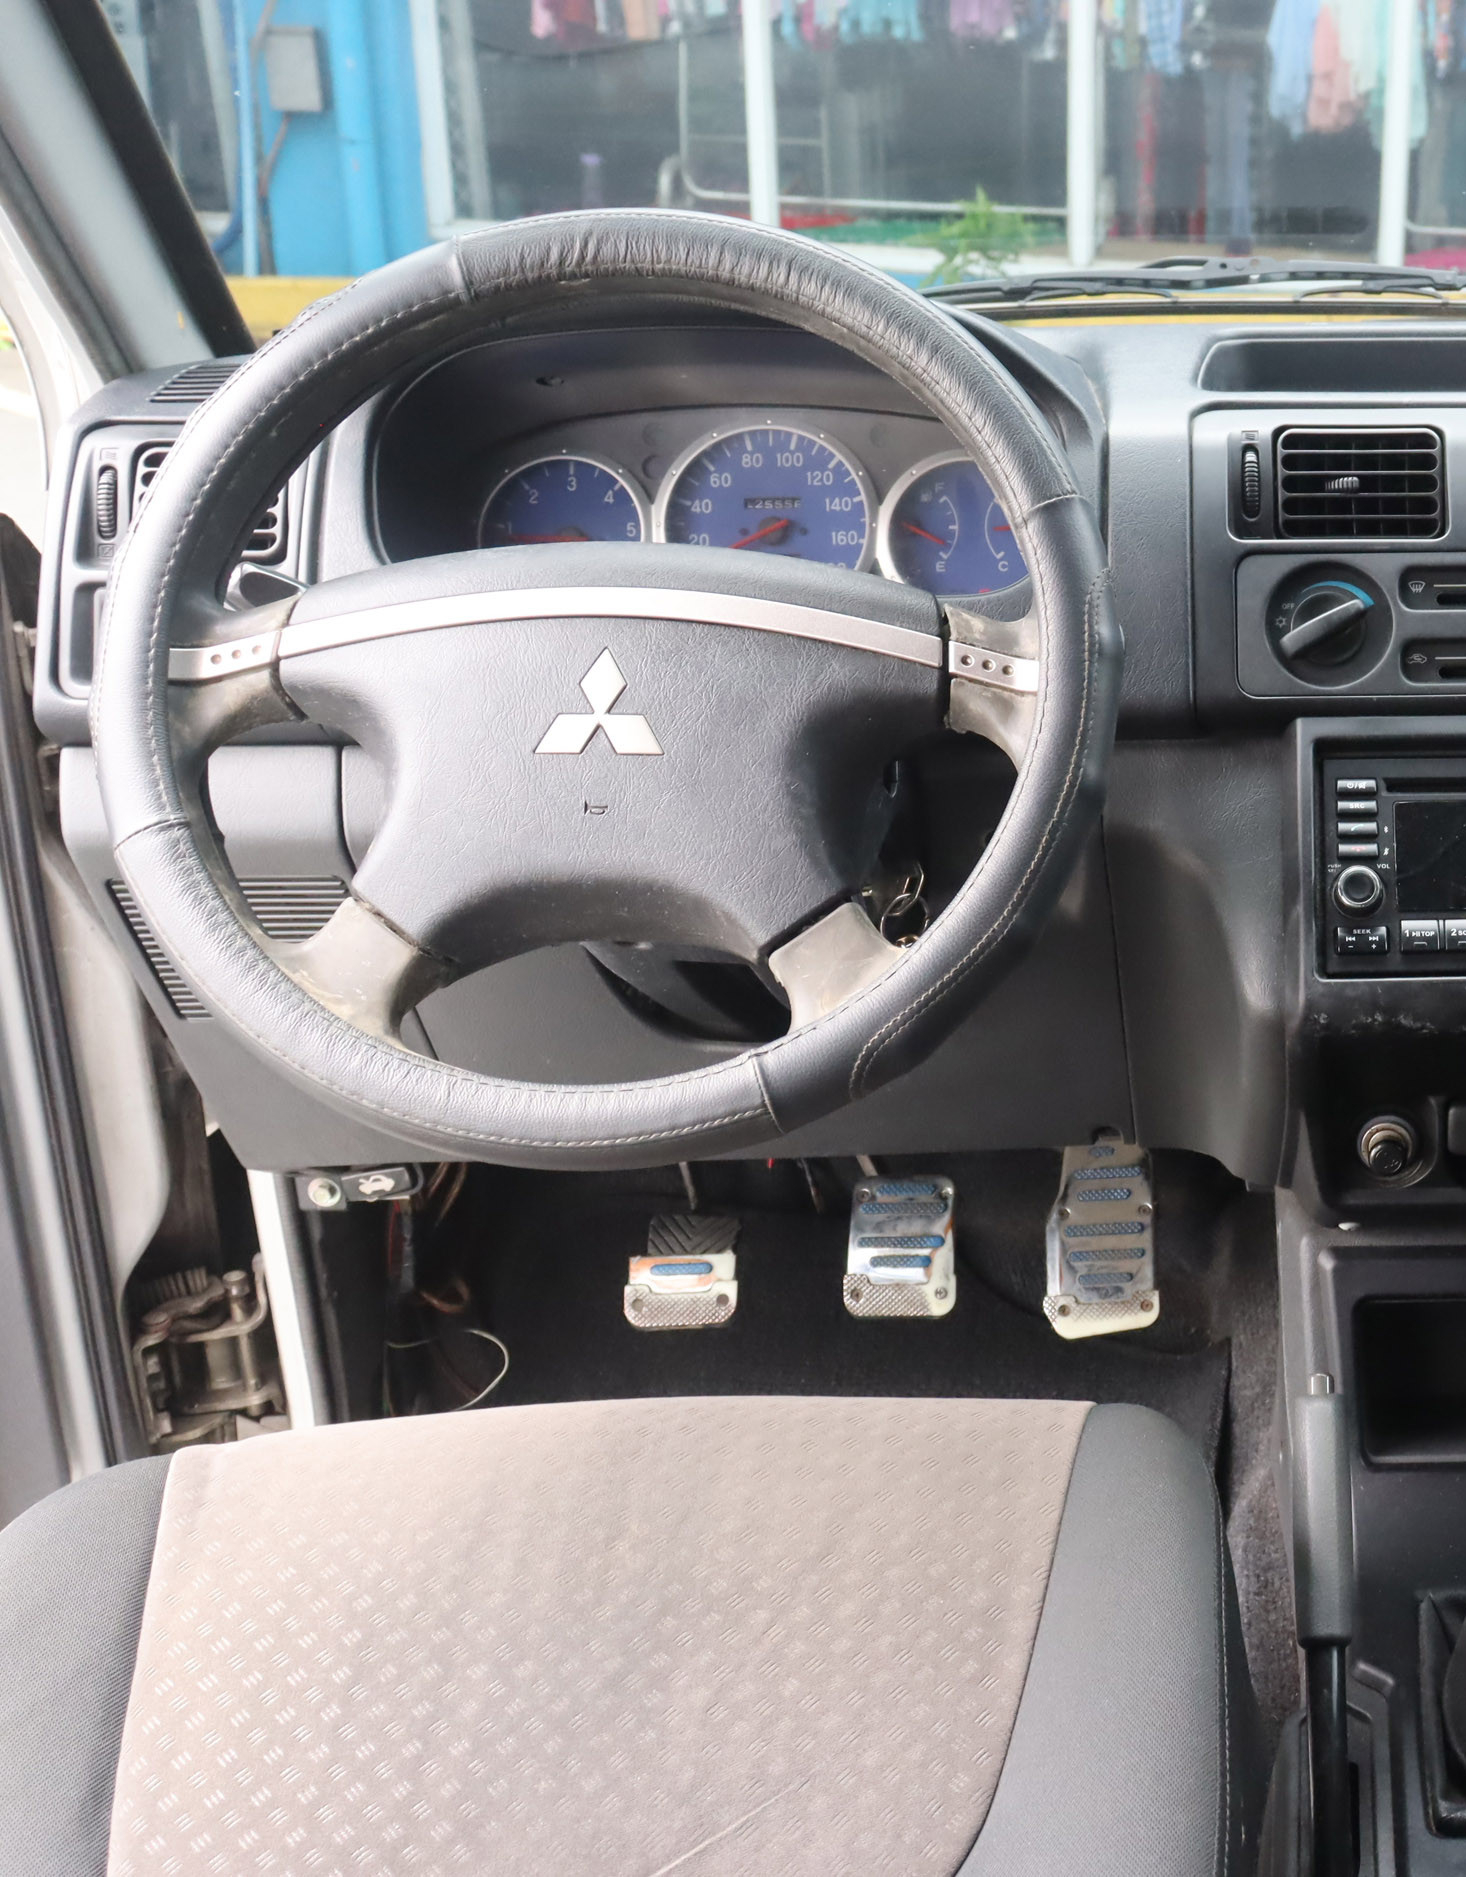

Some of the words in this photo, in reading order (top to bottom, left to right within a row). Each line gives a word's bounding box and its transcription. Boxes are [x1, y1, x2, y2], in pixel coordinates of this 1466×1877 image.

[741, 452, 763, 467] 80
[776, 452, 803, 467] 100
[567, 476, 577, 491] 3
[710, 473, 732, 488] 60
[807, 471, 833, 485] 120
[935, 482, 945, 493] F
[529, 489, 539, 504] 2
[604, 490, 615, 504] 4
[691, 499, 712, 513] 40
[825, 497, 852, 512] 140
[626, 522, 637, 537] 5
[832, 531, 858, 545] 160
[935, 561, 946, 572] E
[998, 561, 1009, 572] C
[1451, 928, 1457, 936] 2
